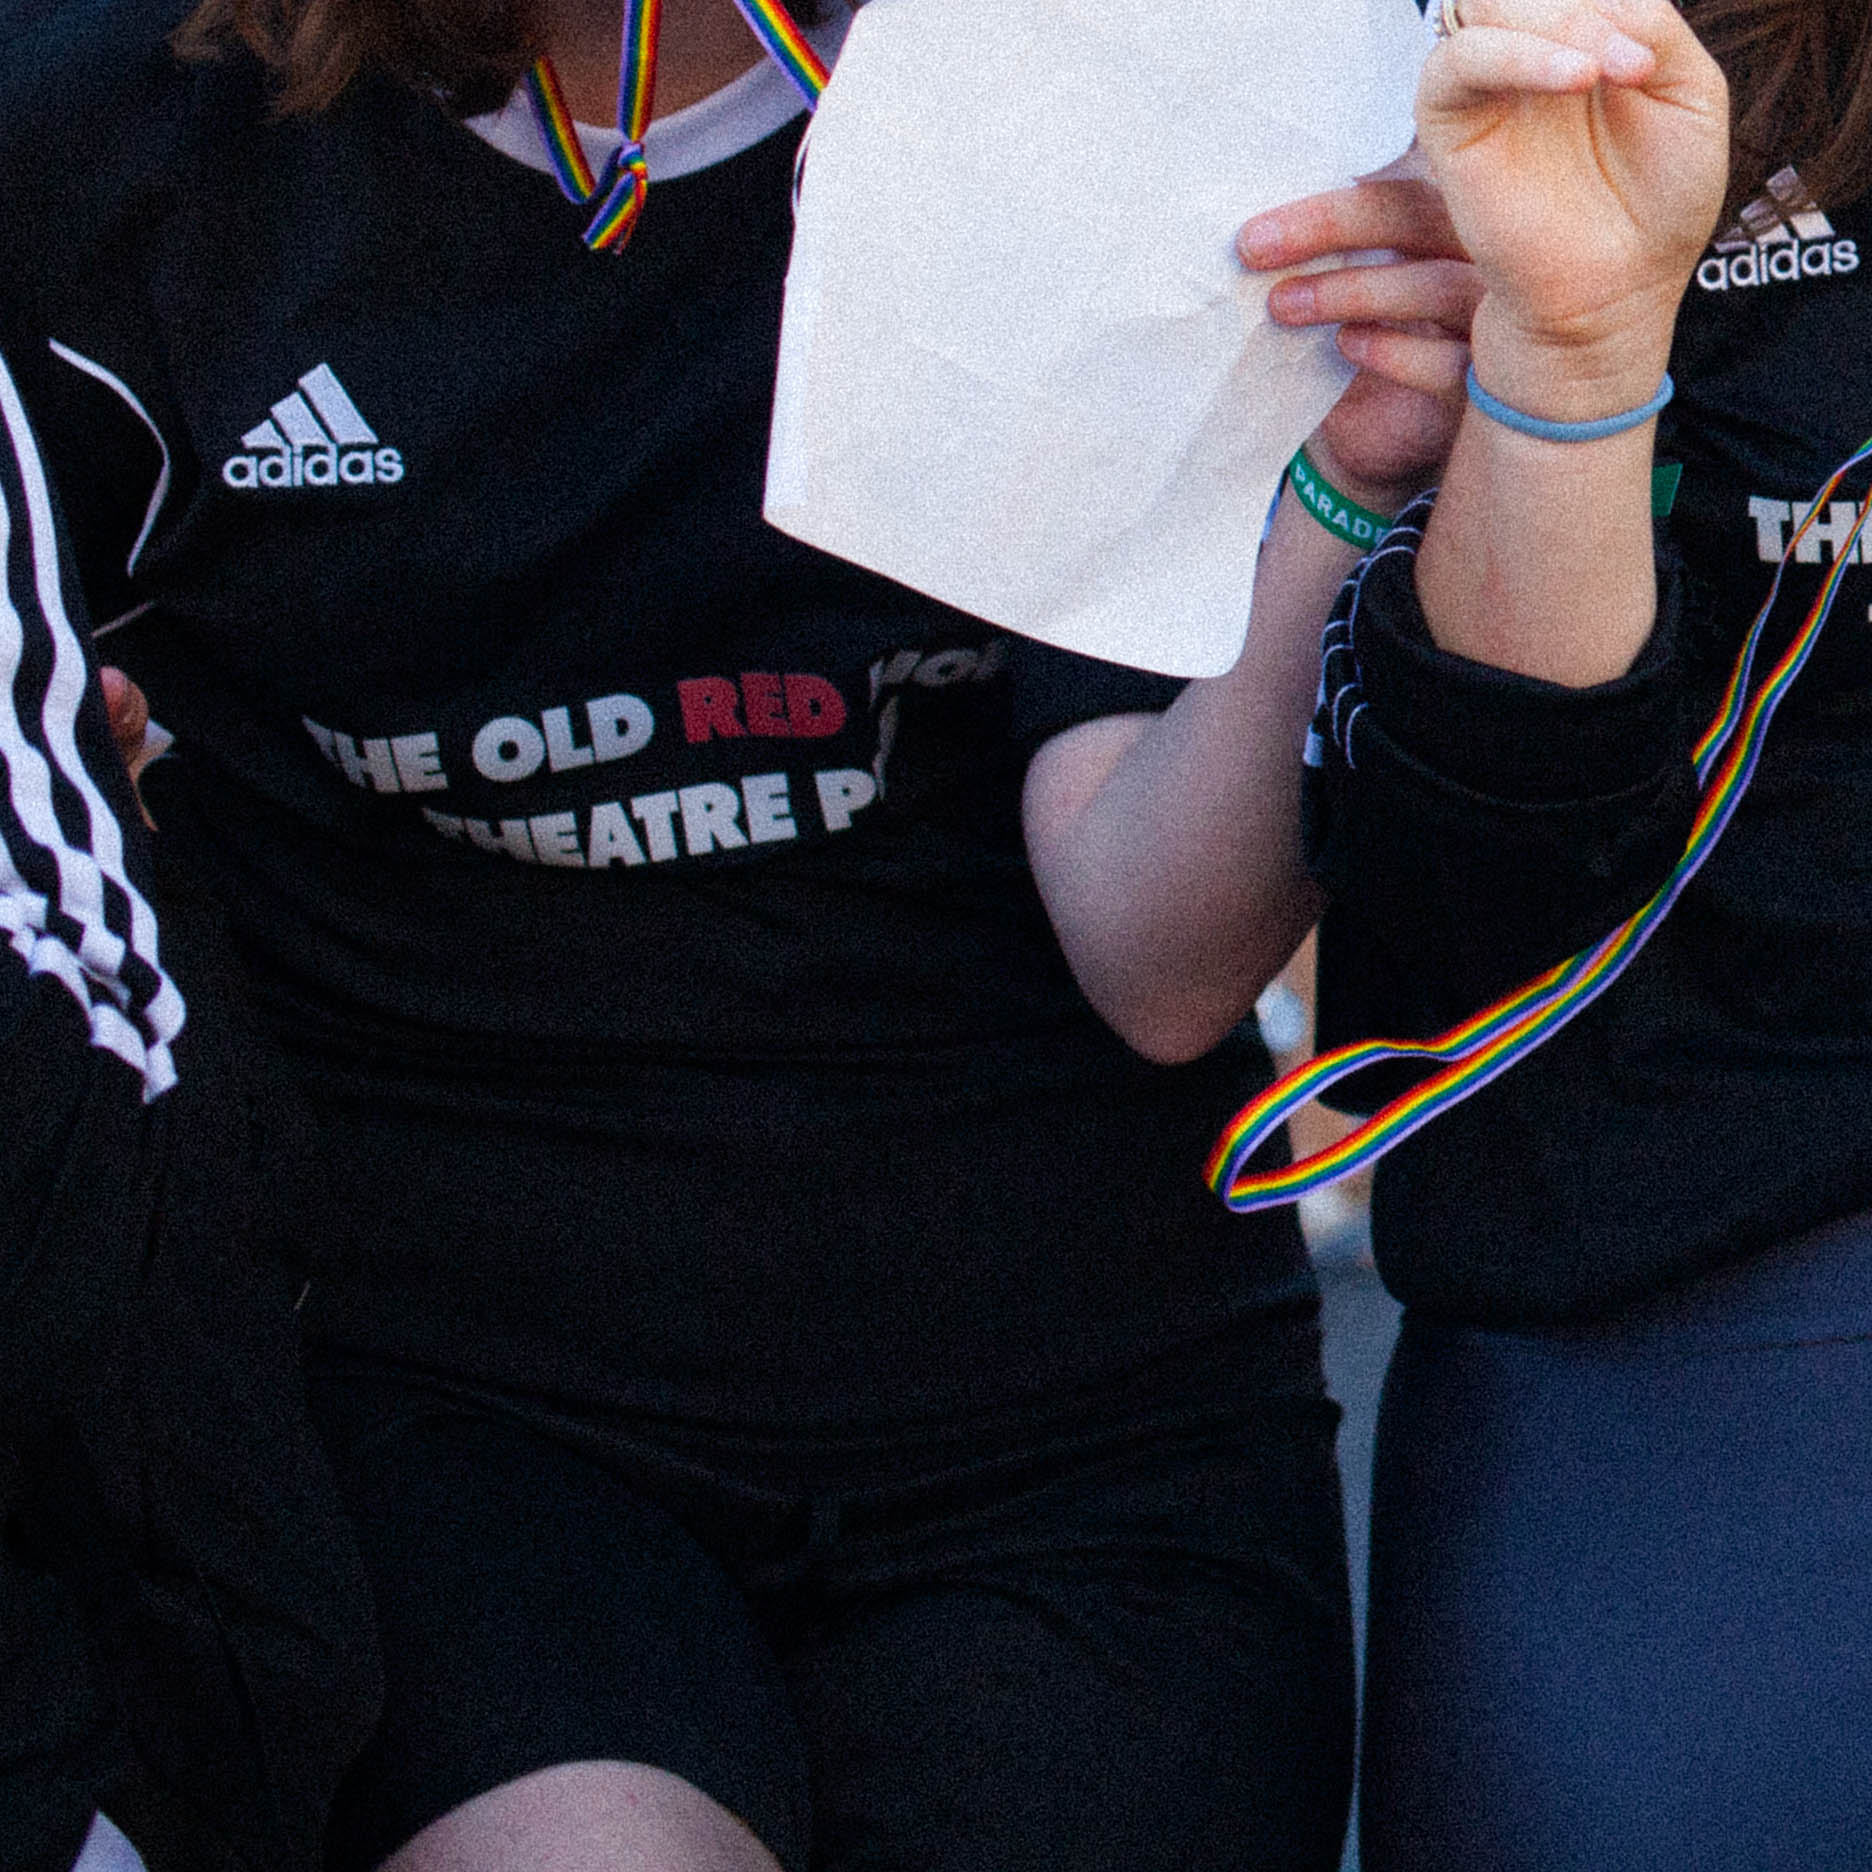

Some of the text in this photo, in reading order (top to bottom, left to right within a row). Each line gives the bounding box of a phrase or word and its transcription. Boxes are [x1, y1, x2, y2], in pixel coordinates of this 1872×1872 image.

[1697, 235, 1860, 292] adidas
[222, 445, 404, 488] adidas
[472, 693, 655, 782] OLD
[677, 673, 847, 743] RED
